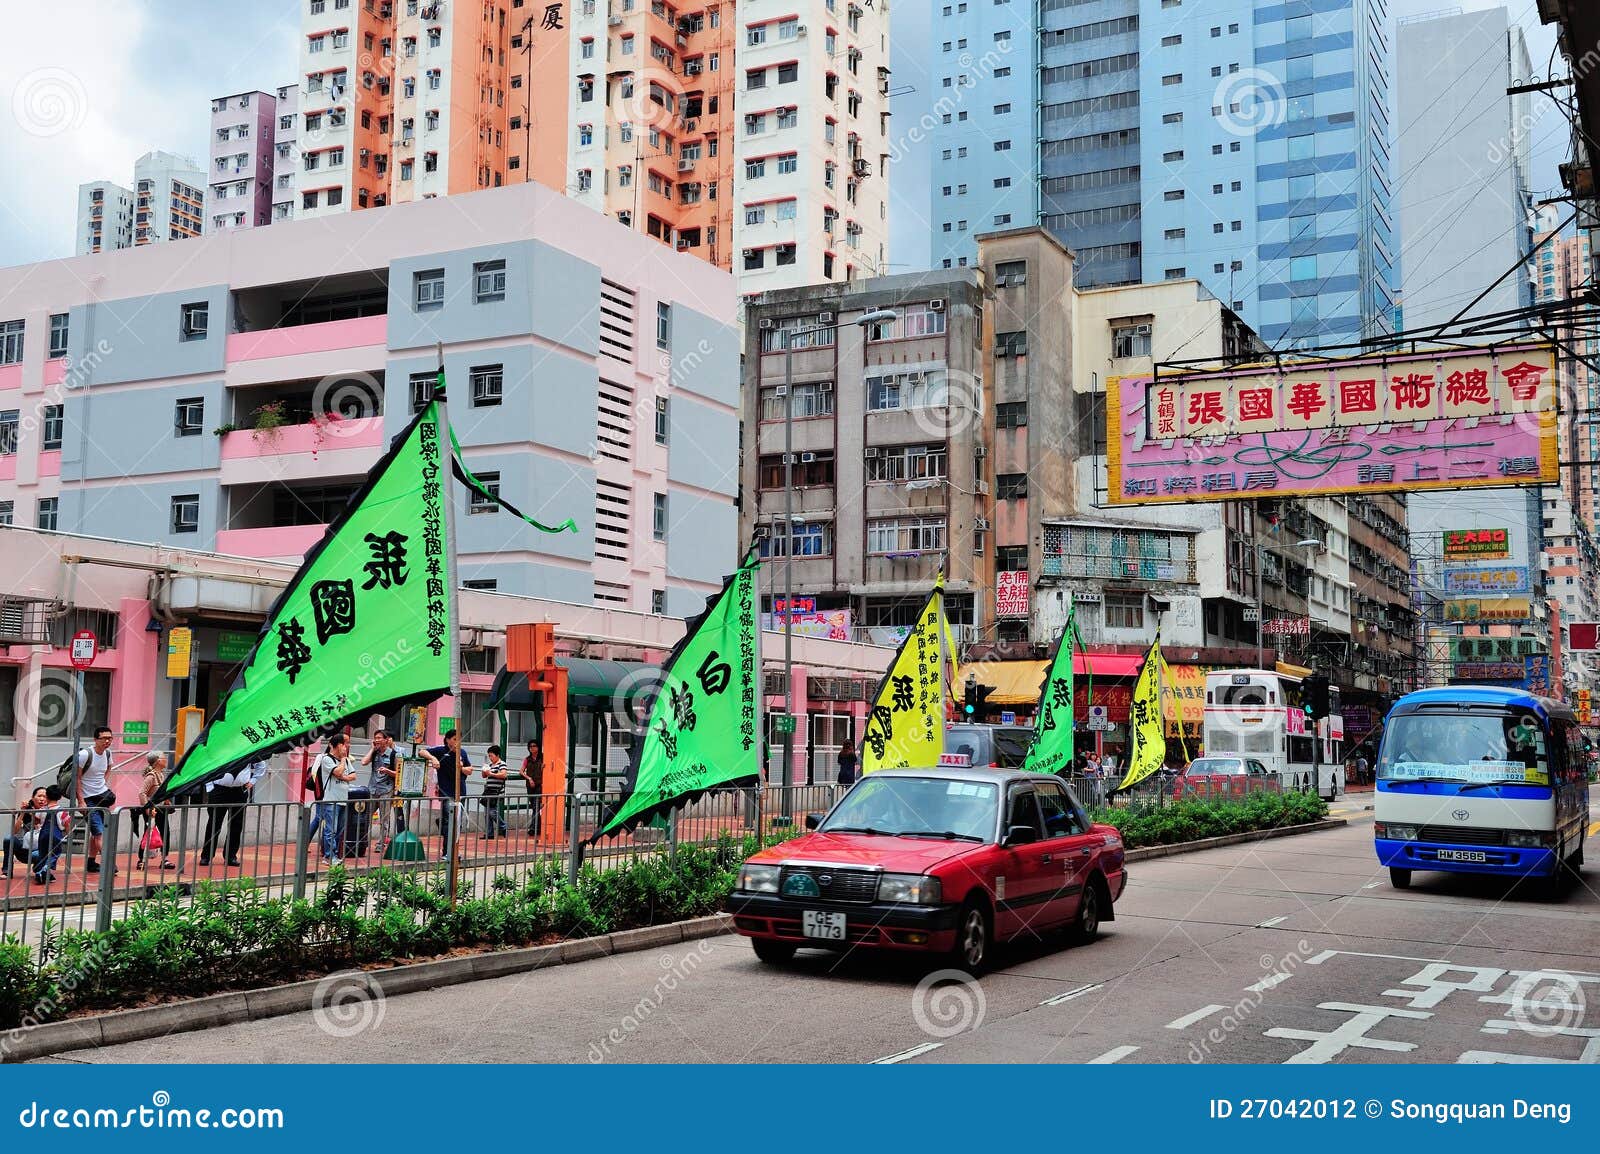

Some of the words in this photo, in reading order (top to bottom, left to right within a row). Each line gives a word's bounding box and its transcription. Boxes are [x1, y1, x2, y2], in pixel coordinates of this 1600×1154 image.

[1188, 360, 1550, 425] 張國華國術總會
[1157, 387, 1175, 433] 白鶴派
[941, 755, 964, 764] TAXI
[1440, 851, 1453, 859] HM
[816, 912, 832, 924] GE
[808, 924, 841, 938] 7173
